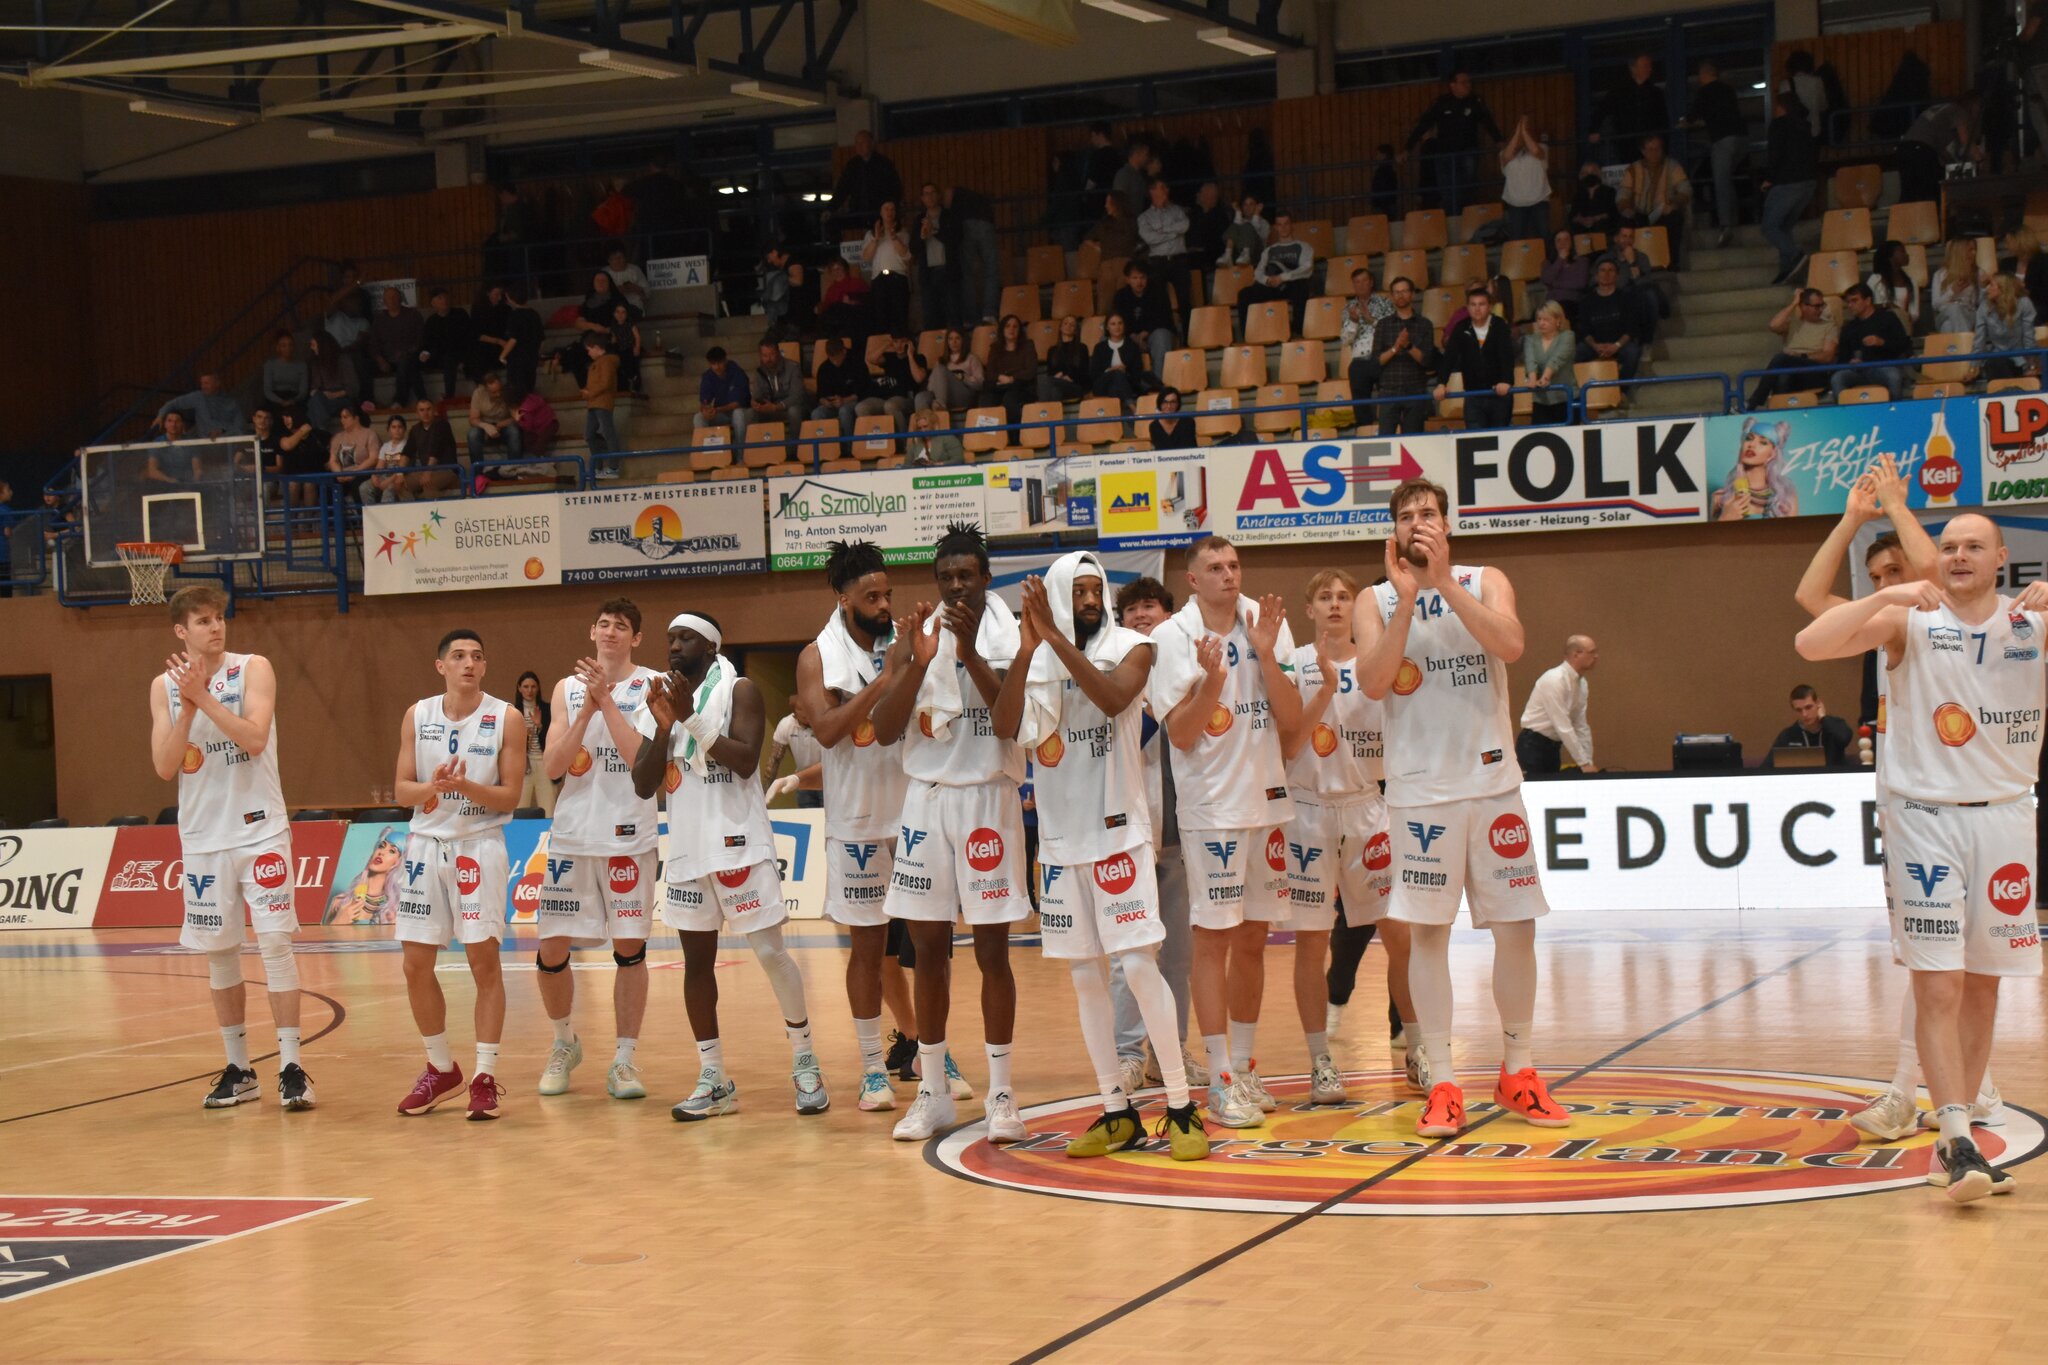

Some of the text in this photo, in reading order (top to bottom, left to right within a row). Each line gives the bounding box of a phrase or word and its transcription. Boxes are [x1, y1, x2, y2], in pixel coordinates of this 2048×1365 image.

[648, 259, 706, 271] TRIBÜNE WEST
[686, 268, 700, 284] A
[1987, 398, 2048, 451] LP
[1132, 456, 1152, 464] Türen
[1157, 453, 1205, 463] Sonnenschutz
[1781, 426, 1883, 477] ZISCH
[1456, 422, 1699, 506] FOLK
[1813, 444, 1921, 496] FRIH
[954, 477, 972, 485] wir?
[1236, 442, 1393, 511] ASE
[1922, 466, 1958, 485] Keli
[564, 484, 758, 506] STEINMETZ-MEISTERBETRIEB
[1110, 492, 1149, 508] AJM
[820, 491, 907, 518] Szmolyan
[935, 501, 975, 509] vermieten
[454, 515, 550, 534] GÄSTEHÄUSER
[936, 512, 979, 520] versichern
[1240, 513, 1297, 529] Andreas
[1301, 511, 1344, 526] Schuh
[1459, 511, 1632, 530] Gas Wasser Heizung Solar
[455, 530, 551, 549] BURGENLAND
[589, 526, 631, 543] STEIN
[784, 523, 888, 539] Ing. Anton Szmolyan
[1302, 529, 1340, 539] Oberanger
[690, 537, 740, 552] JANDL
[785, 541, 832, 551] 7471 Rechn
[1119, 537, 1193, 548] www.fenster-ajm.at
[776, 555, 803, 568] 0664
[415, 571, 508, 586] www.gh-burgenland.at
[567, 561, 762, 582] 7400 Oberwart www.steinjandl.at
[1416, 594, 1443, 621] 14
[1227, 641, 1239, 667] 9
[1971, 632, 1987, 665] 7
[1425, 653, 1487, 672] burgen
[1451, 670, 1488, 687] land
[956, 706, 993, 723] urg
[1234, 699, 1271, 716] burge
[1978, 706, 2041, 729] burgen
[448, 729, 459, 755] 6
[1352, 743, 1384, 758] land
[1903, 801, 1938, 816] SPALDING
[1492, 824, 1527, 847] Keli
[968, 837, 1000, 860] Keli
[1403, 853, 1441, 864] VOLKSBANK
[255, 860, 286, 880] Keli
[456, 868, 478, 884] eli
[608, 865, 635, 881] Keli
[1096, 858, 1132, 883] Keli
[1402, 868, 1447, 887] cremesso
[514, 884, 541, 900] Kel
[981, 888, 1010, 900] DRUCK
[1288, 886, 1325, 903] emesso
[735, 899, 762, 913] DRUCK
[1903, 899, 1952, 909] VOLKSBANK
[187, 912, 223, 927] cremesso
[1115, 909, 1148, 925] DRUCK
[1989, 922, 2036, 938] GRÖNE
[2009, 933, 2039, 949] DRUK
[0, 1208, 220, 1228] 2day
